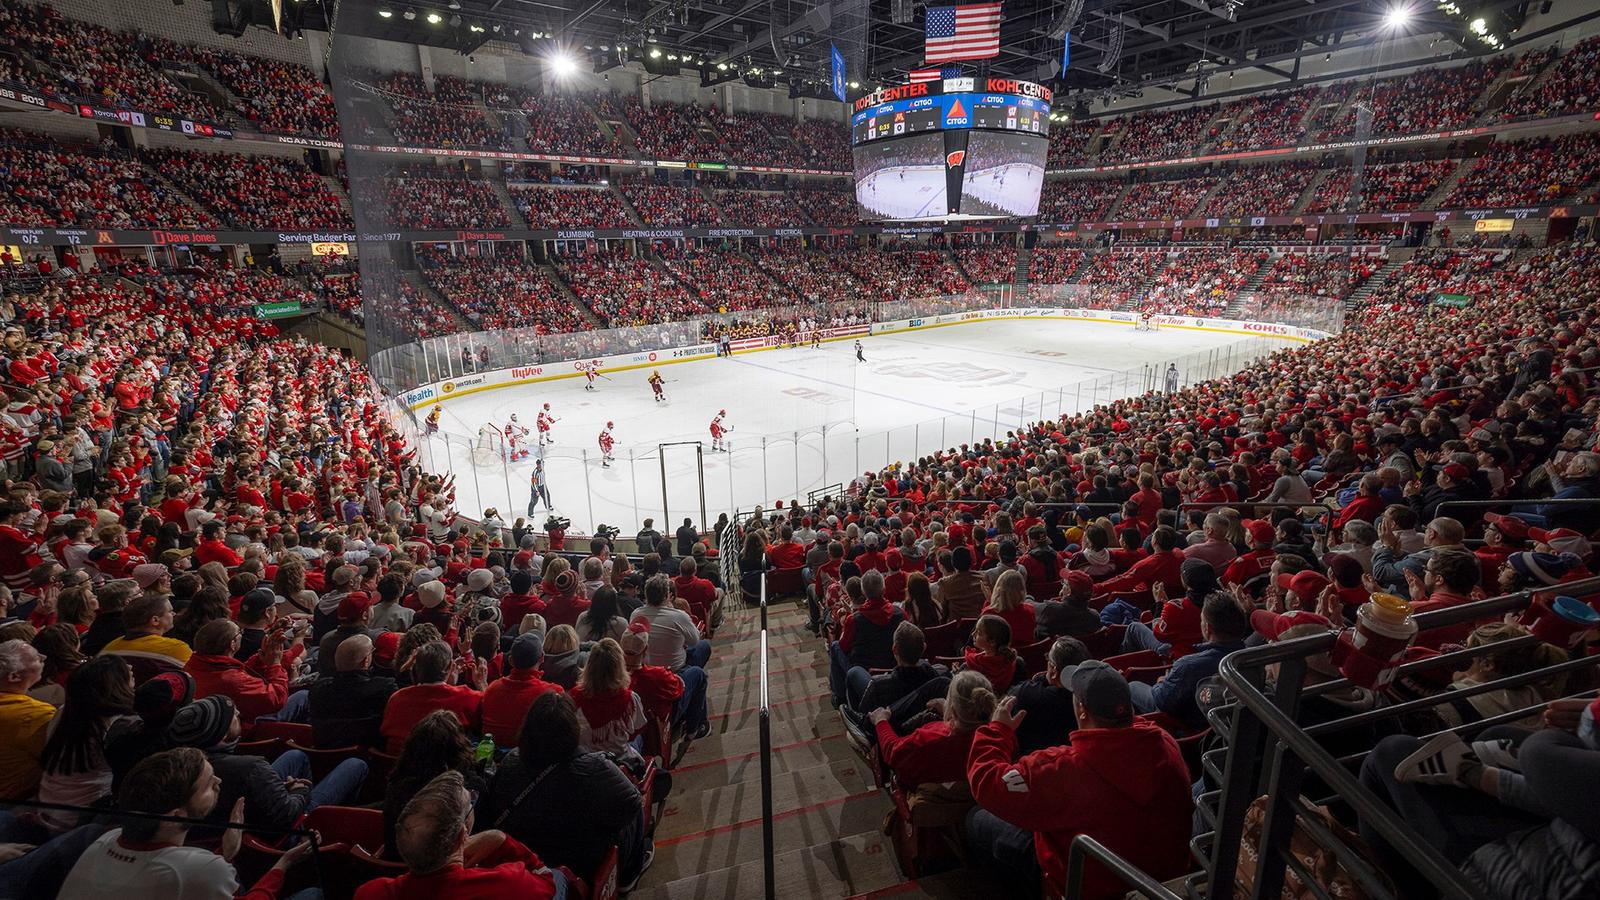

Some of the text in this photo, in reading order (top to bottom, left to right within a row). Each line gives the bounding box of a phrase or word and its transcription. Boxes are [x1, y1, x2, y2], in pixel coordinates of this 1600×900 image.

[987, 79, 1021, 94] KOHL
[21, 94, 45, 106] 2013
[855, 93, 876, 111] KOHL
[877, 83, 928, 103] CENTER
[93, 109, 118, 120] TOYOTA
[278, 136, 308, 145] NCAA
[946, 150, 965, 169] W
[22, 235, 39, 244] 0/2
[68, 235, 81, 244] 1/2
[166, 232, 217, 242] Dave Jones
[279, 232, 313, 243] Serving
[313, 232, 342, 243] Badger
[363, 233, 383, 241] Since
[383, 232, 401, 241] 1977
[1243, 323, 1288, 335] KOHL'S
[804, 330, 835, 342] BAERS
[407, 388, 433, 404] Health
[1001, 769, 1029, 793] W
